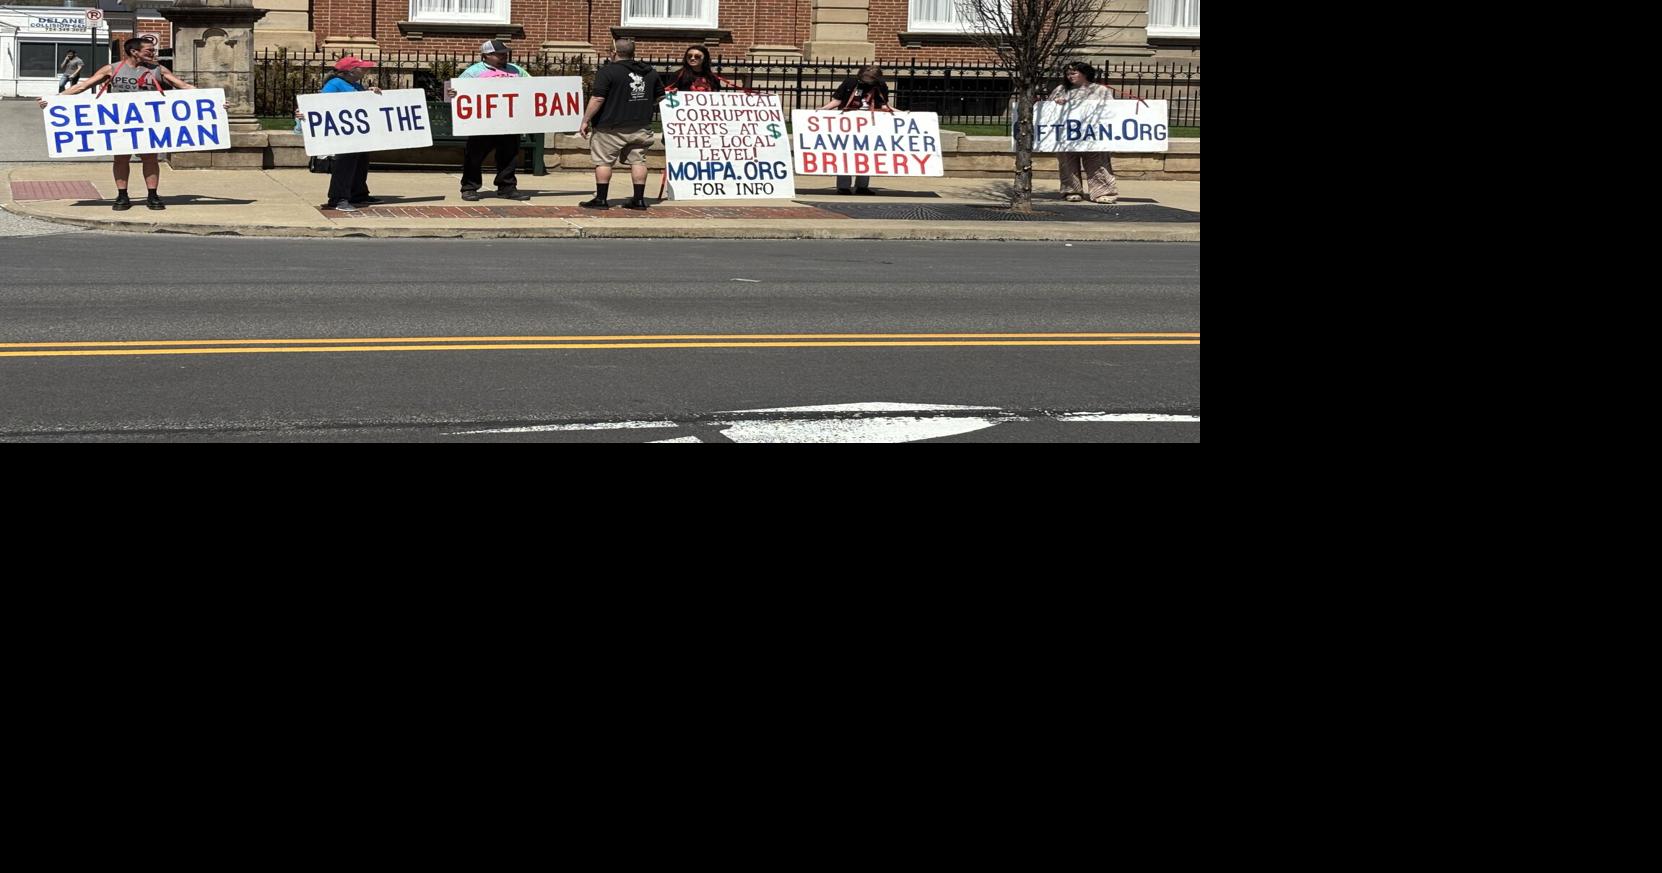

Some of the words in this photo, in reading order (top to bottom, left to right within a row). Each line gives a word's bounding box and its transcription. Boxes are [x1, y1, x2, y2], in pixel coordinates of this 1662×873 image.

[115, 76, 158, 86] PEOL
[456, 93, 518, 120] GIFT
[534, 91, 580, 117] BAN
[684, 93, 777, 107] POLITICAL
[49, 99, 218, 127] SENATOR
[308, 109, 370, 138] PASS
[379, 104, 425, 132] THE
[676, 108, 782, 122] CORRUPTION
[666, 122, 729, 135] STARTS
[740, 122, 759, 135] AT
[807, 116, 868, 133] STOP
[893, 117, 929, 135] PA.
[54, 124, 220, 153] PITTMAN
[673, 135, 712, 148] THE
[721, 135, 776, 148] LOCAL
[799, 133, 937, 152] LAWMAKER
[699, 147, 759, 163] LEVEL!
[802, 151, 932, 175] BRIBERY
[667, 161, 788, 181] MOHPA.ORG
[693, 182, 726, 196] FOR
[736, 182, 774, 196] INFO
